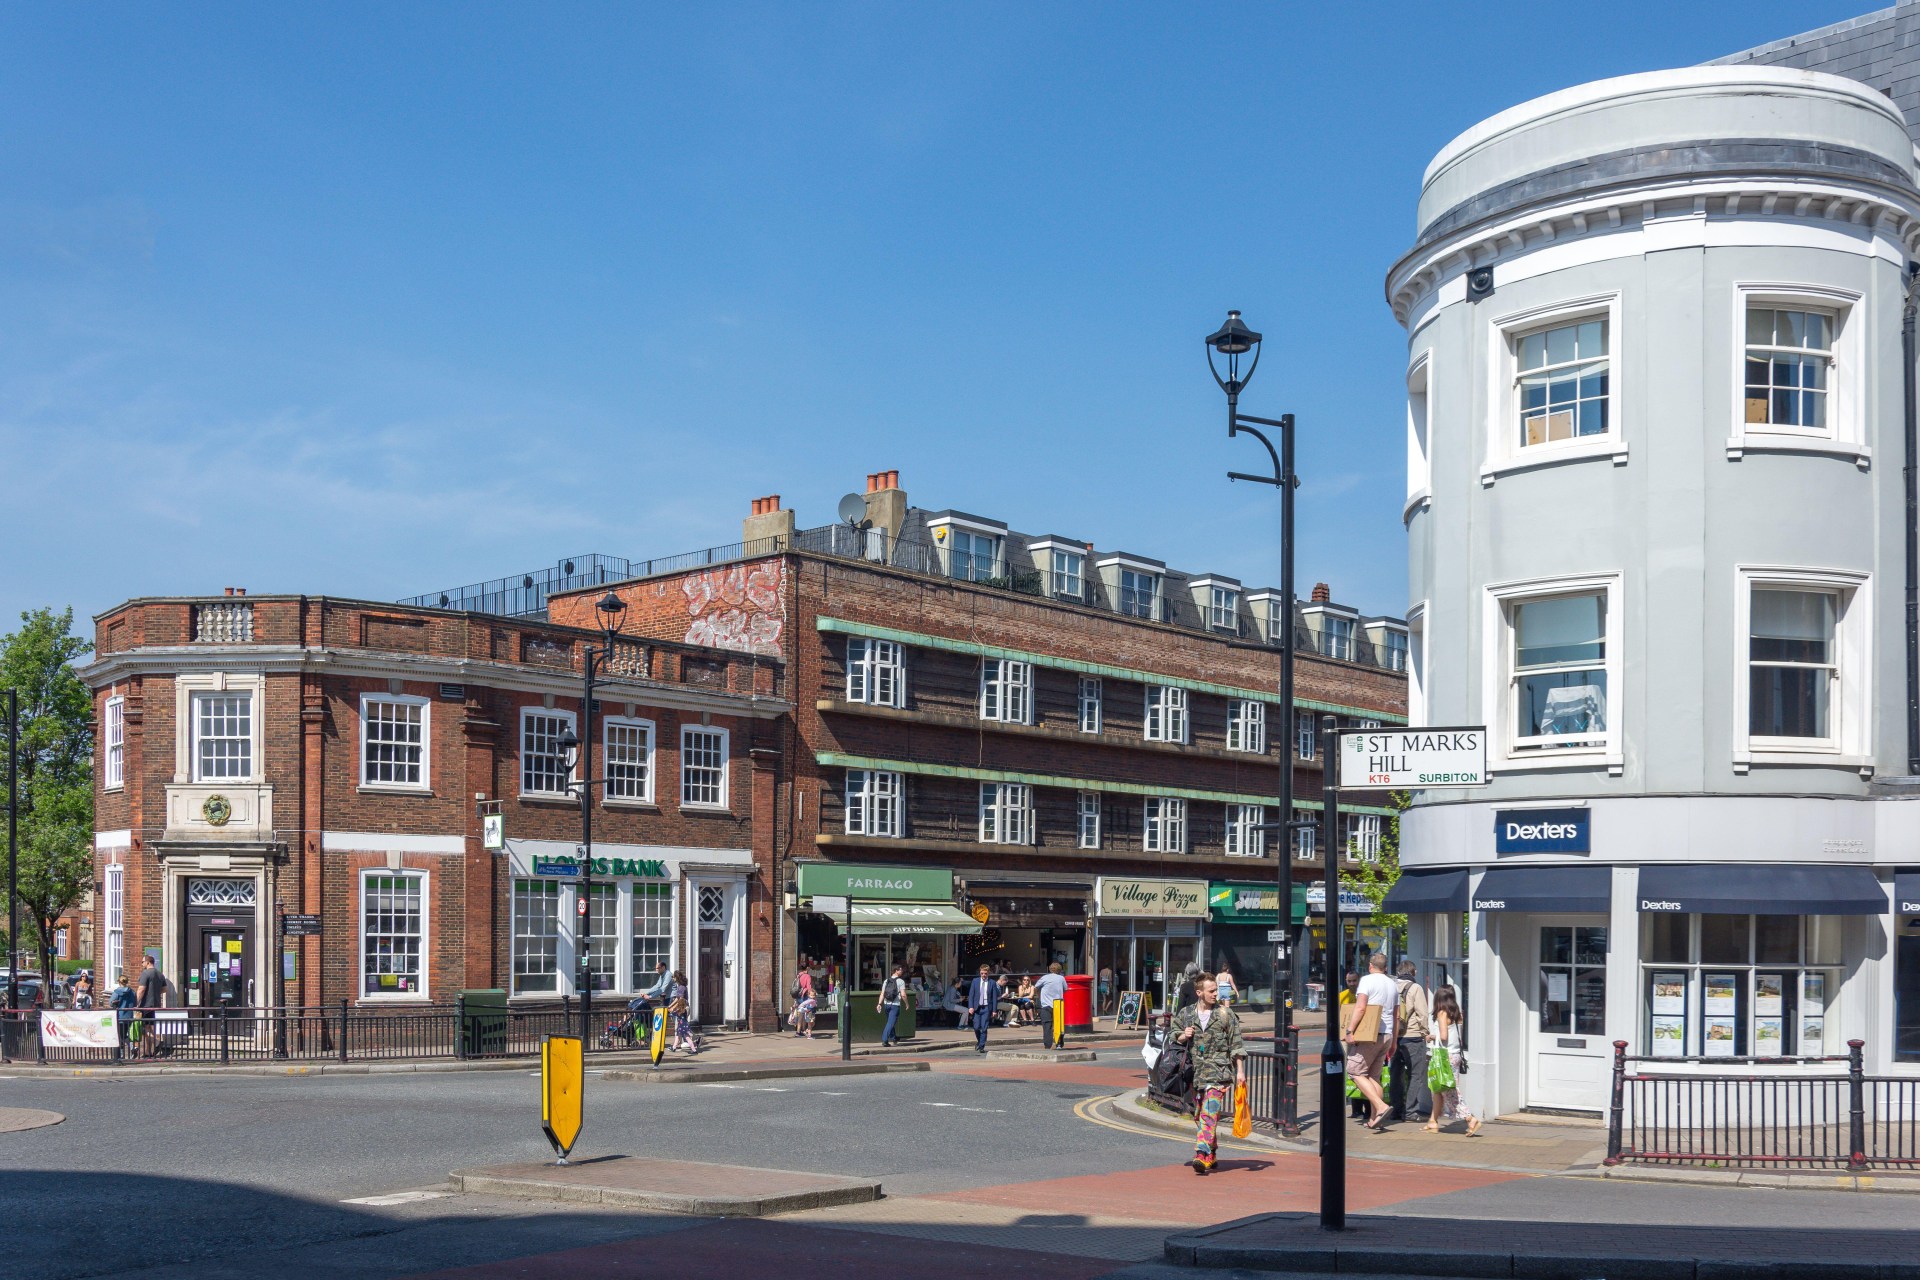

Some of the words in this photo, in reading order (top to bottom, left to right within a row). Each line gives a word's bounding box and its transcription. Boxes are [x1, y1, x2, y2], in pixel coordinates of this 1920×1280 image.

[1369, 735, 1392, 752] ST
[1402, 733, 1477, 752] MARKS
[1369, 756, 1412, 773] HILL
[1369, 774, 1391, 783] KT6
[1419, 773, 1478, 783] SURBITON
[1506, 822, 1577, 840] Dexters
[531, 854, 608, 875] LDS
[612, 858, 666, 877] BANK
[847, 878, 913, 889] FARRAGO
[1111, 883, 1158, 908] Village
[1163, 886, 1198, 909] Pizza
[1209, 889, 1232, 904] SUBWAY
[1234, 890, 1279, 911] SUBWA
[851, 906, 943, 916] ARRAGO
[1475, 900, 1505, 909] Dexters
[1642, 900, 1681, 910] Dexters
